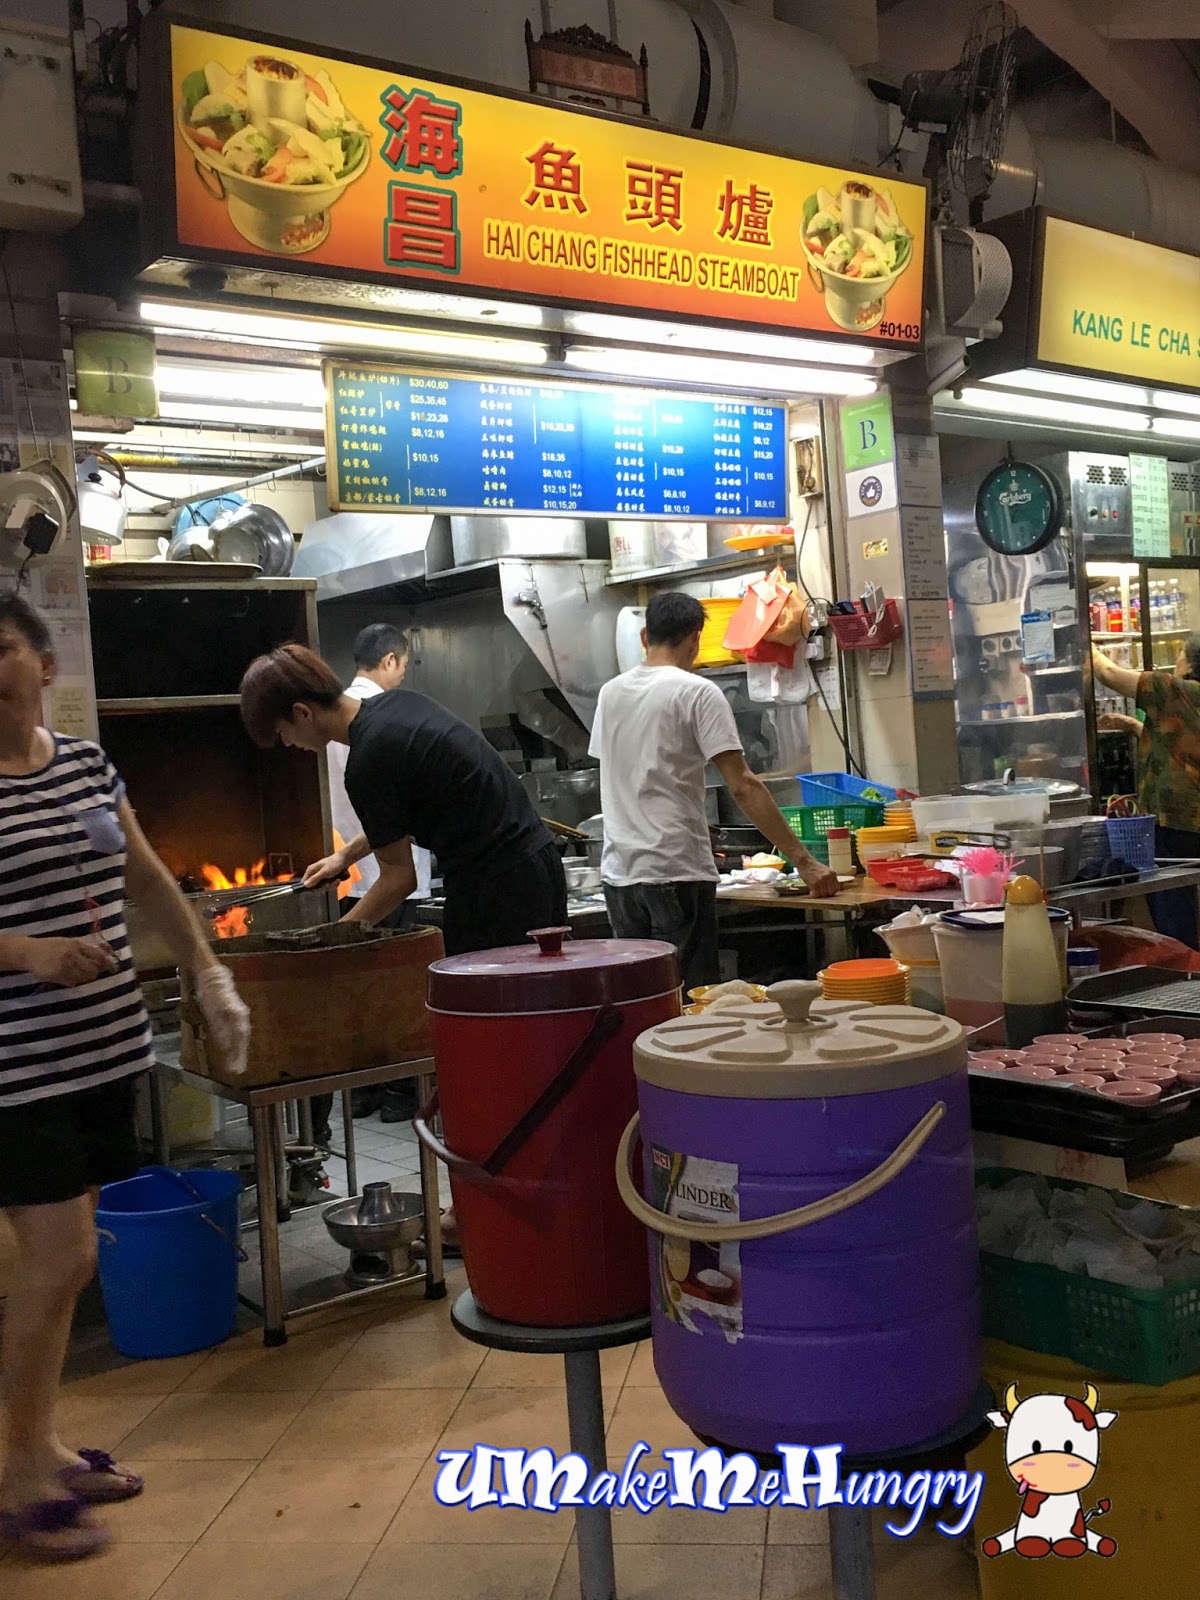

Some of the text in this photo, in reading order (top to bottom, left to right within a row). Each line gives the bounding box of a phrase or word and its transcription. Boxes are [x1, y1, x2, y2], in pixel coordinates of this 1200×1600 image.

[382, 86, 462, 273] 海昌
[525, 140, 774, 247] 魚頭爐
[486, 223, 800, 300] HAI CHANG FISHHEAD STEAMBOAT
[879, 320, 920, 340] #01-03
[1072, 308, 1124, 343] KANG
[1130, 321, 1152, 348] LE
[1158, 327, 1191, 356] CHA
[104, 355, 133, 394] B
[859, 419, 877, 450] B
[998, 491, 1032, 506] Carlsberg
